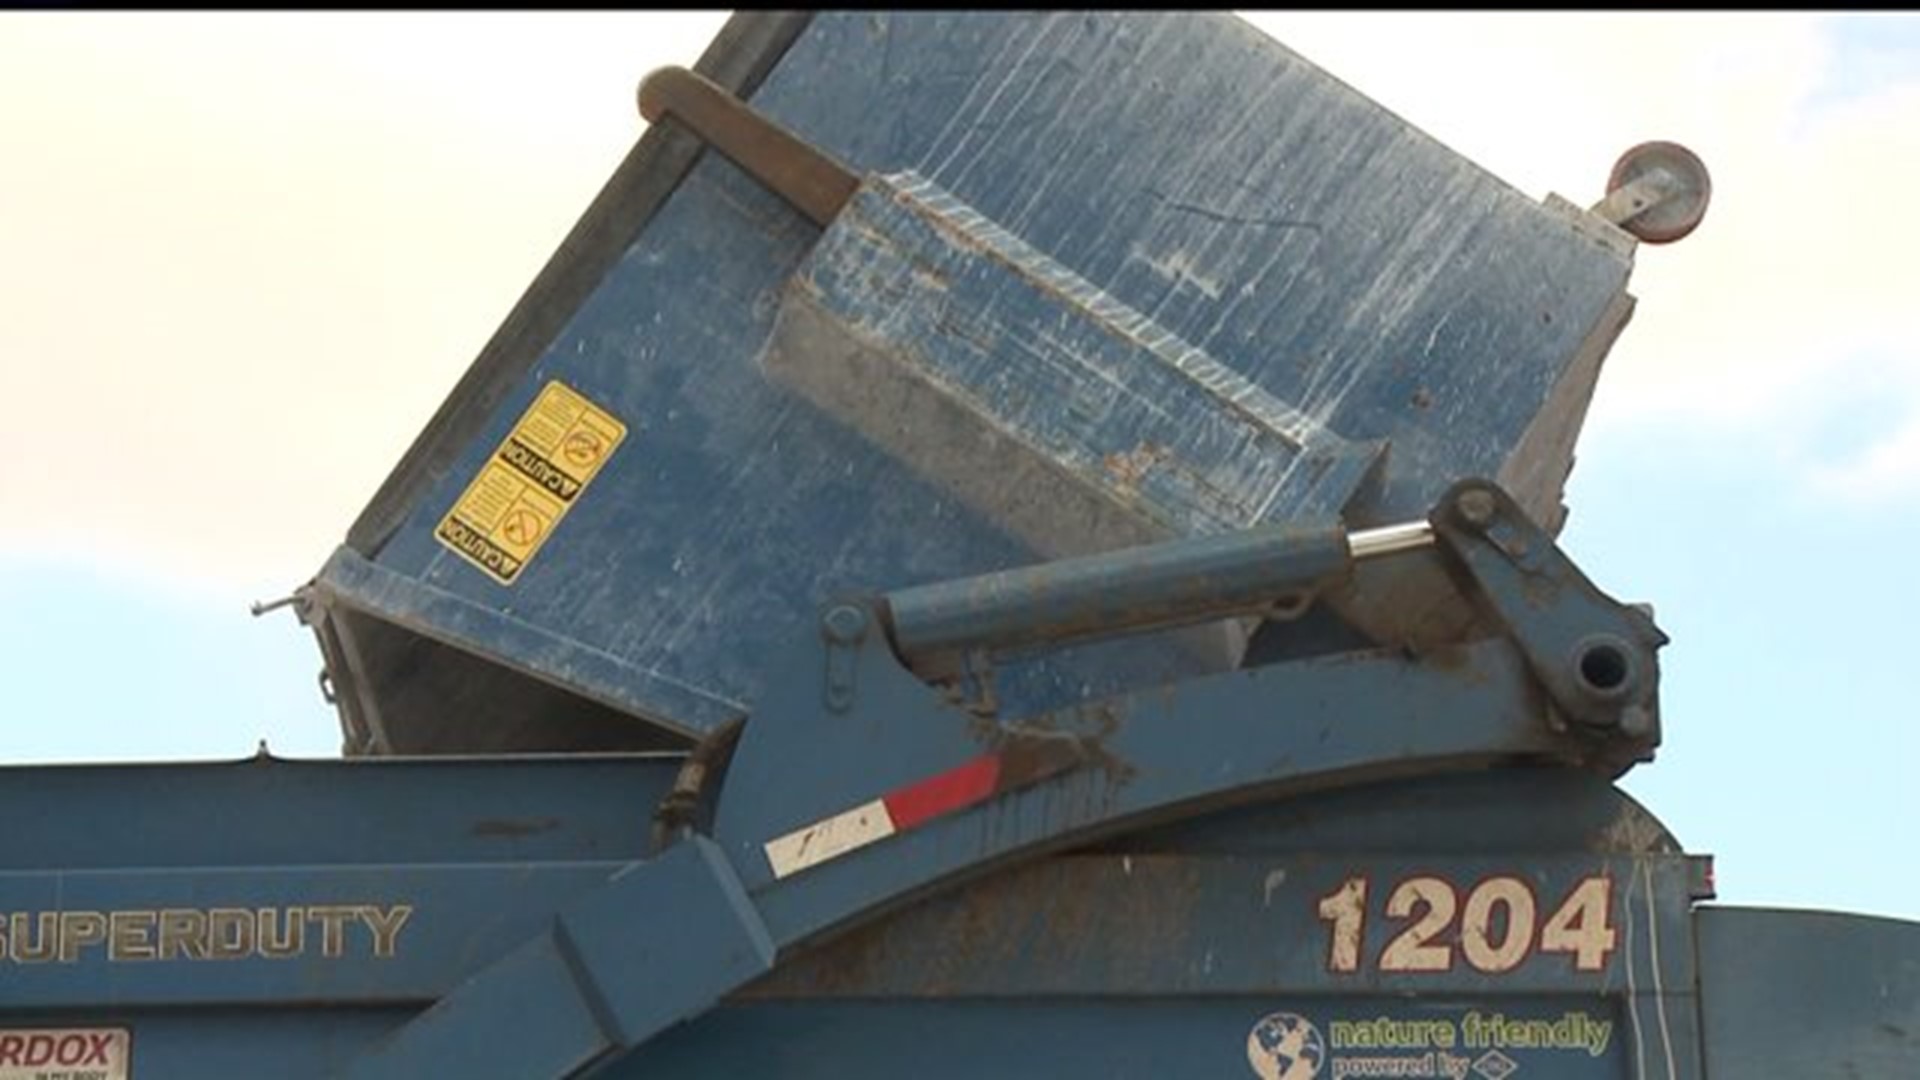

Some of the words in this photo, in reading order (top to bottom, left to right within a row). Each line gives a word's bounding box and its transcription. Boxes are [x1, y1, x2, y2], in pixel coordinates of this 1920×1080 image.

[503, 441, 564, 493] CAUTION
[443, 520, 500, 568] CAUTION
[0, 905, 412, 963] UPERDUTY
[1315, 873, 1618, 974] 1204
[1331, 1016, 1456, 1048] nature
[1461, 1011, 1612, 1055] friendly
[1331, 1052, 1435, 1080] powered
[1438, 1051, 1471, 1080] by
